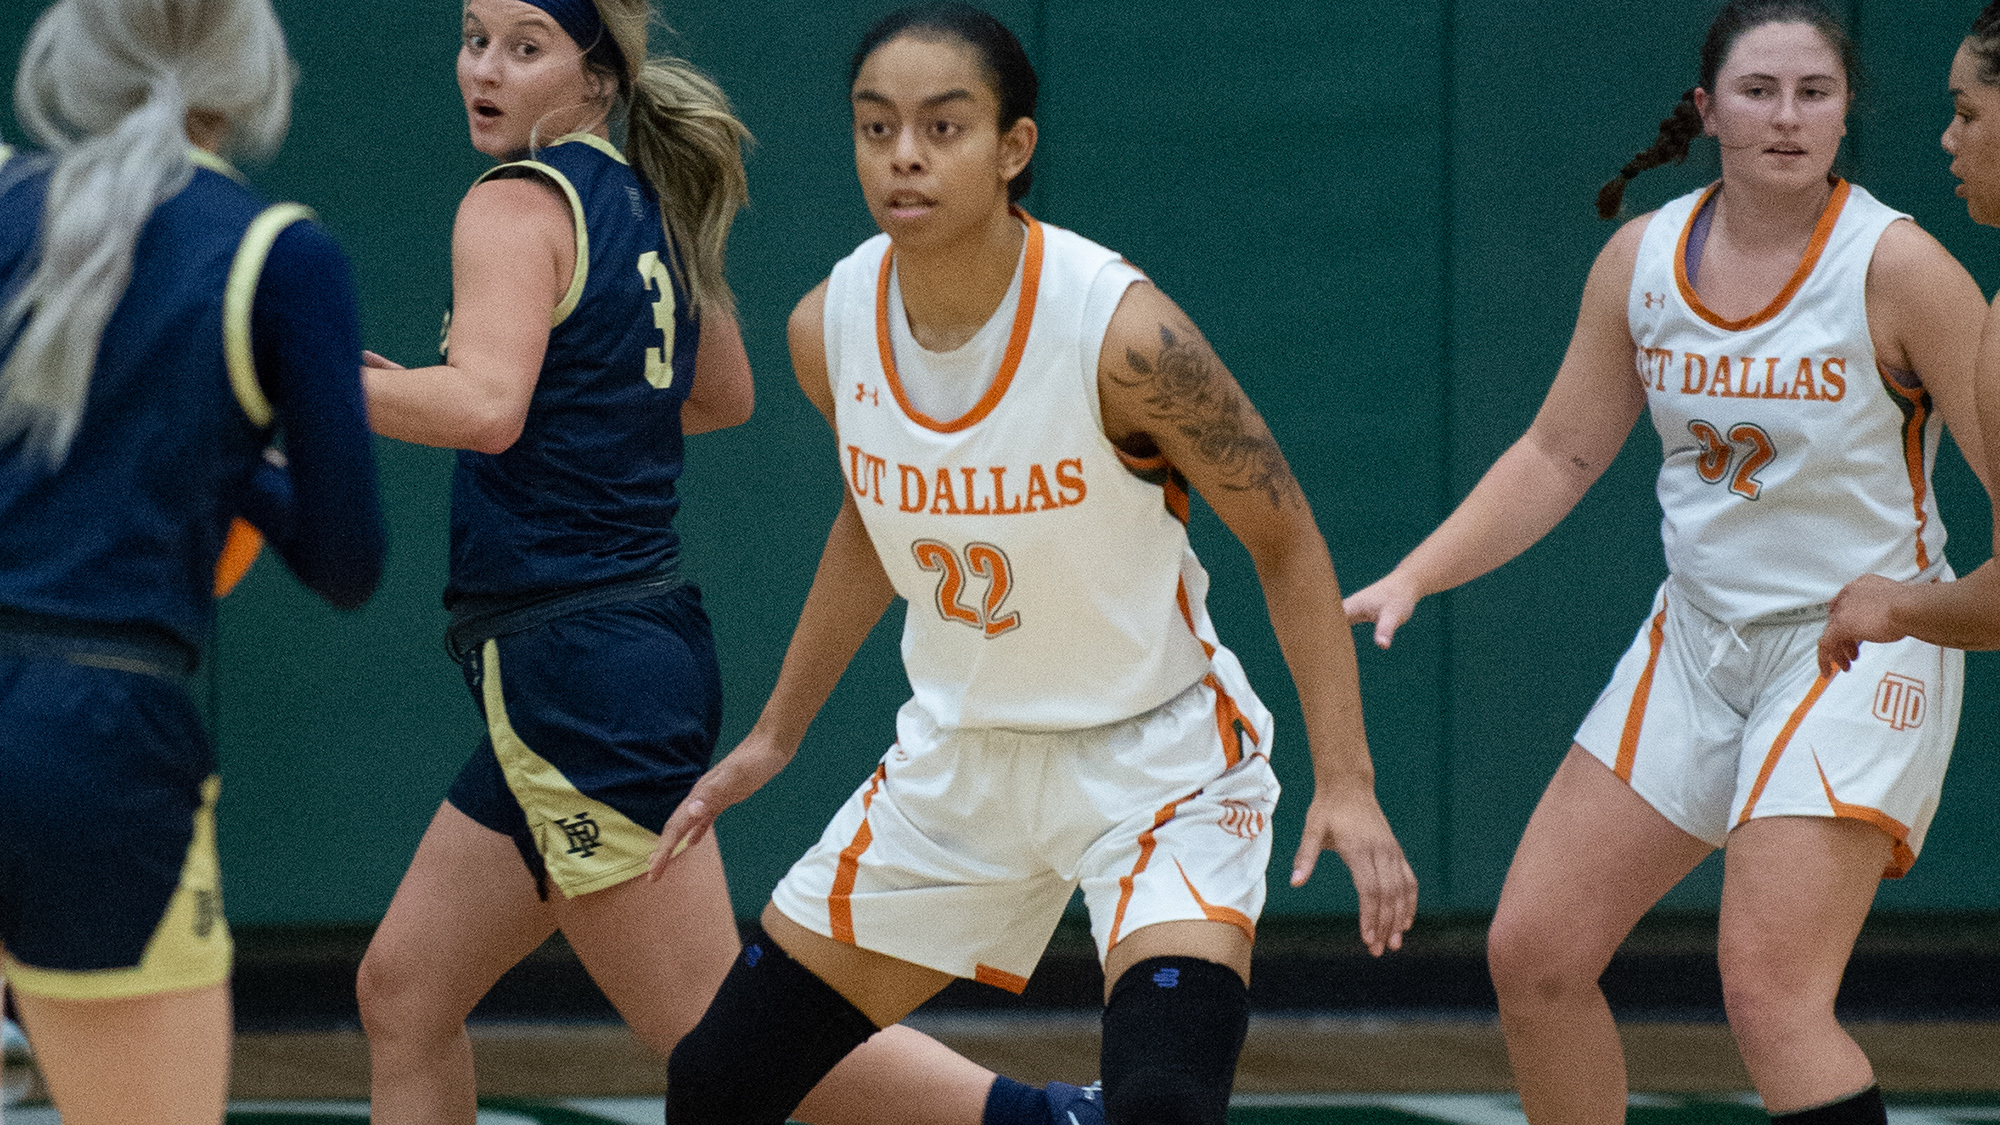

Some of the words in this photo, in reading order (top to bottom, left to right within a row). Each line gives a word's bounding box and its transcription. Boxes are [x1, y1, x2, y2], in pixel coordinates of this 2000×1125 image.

[637, 250, 676, 389] 3
[1681, 352, 1847, 403] DALLAS
[847, 445, 886, 506] UT
[897, 457, 1087, 516] DALLAS
[911, 538, 1021, 640] 22
